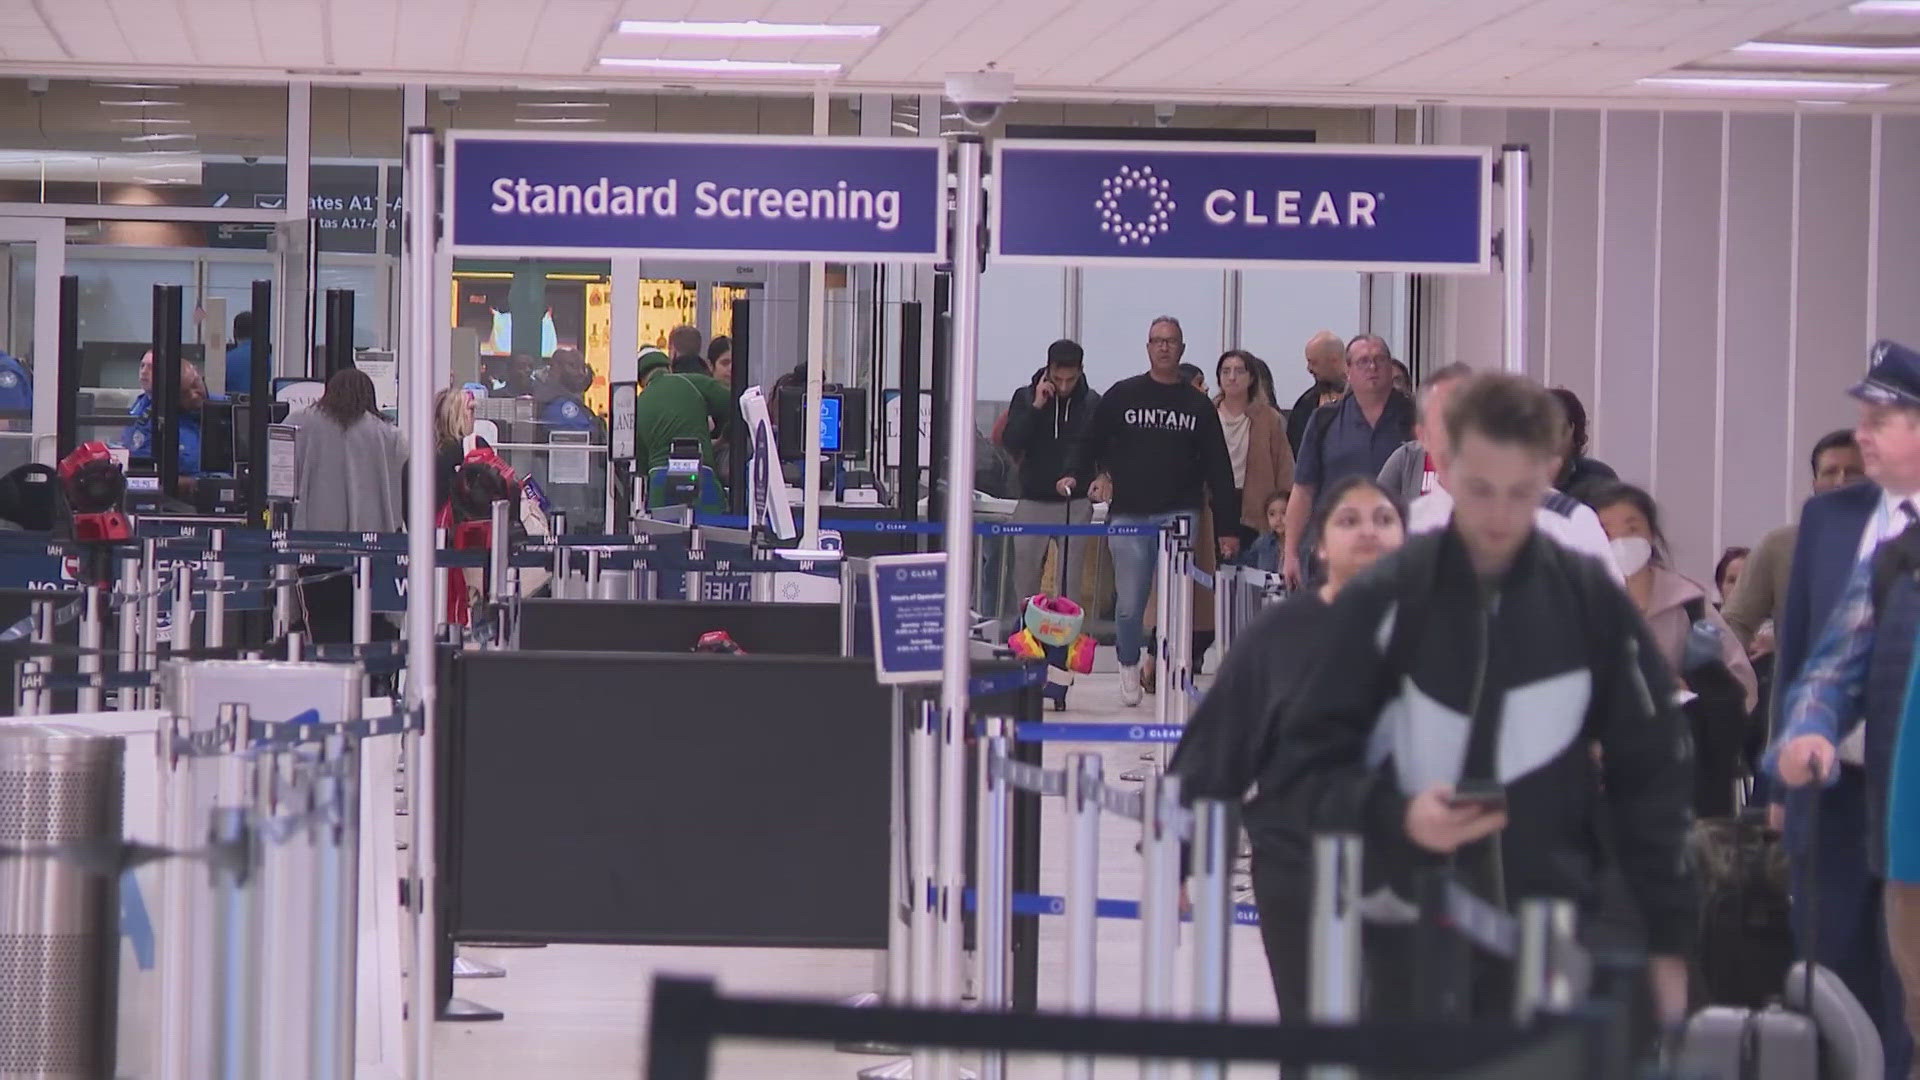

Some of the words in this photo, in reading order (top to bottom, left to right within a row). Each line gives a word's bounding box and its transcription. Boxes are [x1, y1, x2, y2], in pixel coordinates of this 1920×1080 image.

[309, 195, 343, 210] ates
[491, 177, 678, 215] Standard
[694, 181, 900, 229] Screening
[1205, 188, 1376, 226] CLEAR
[1124, 408, 1197, 431] GINTANI
[362, 532, 378, 543] IAH
[46, 545, 63, 556] IAH
[201, 550, 218, 561] IAH
[300, 553, 316, 565] IAH
[22, 675, 43, 689] IAH
